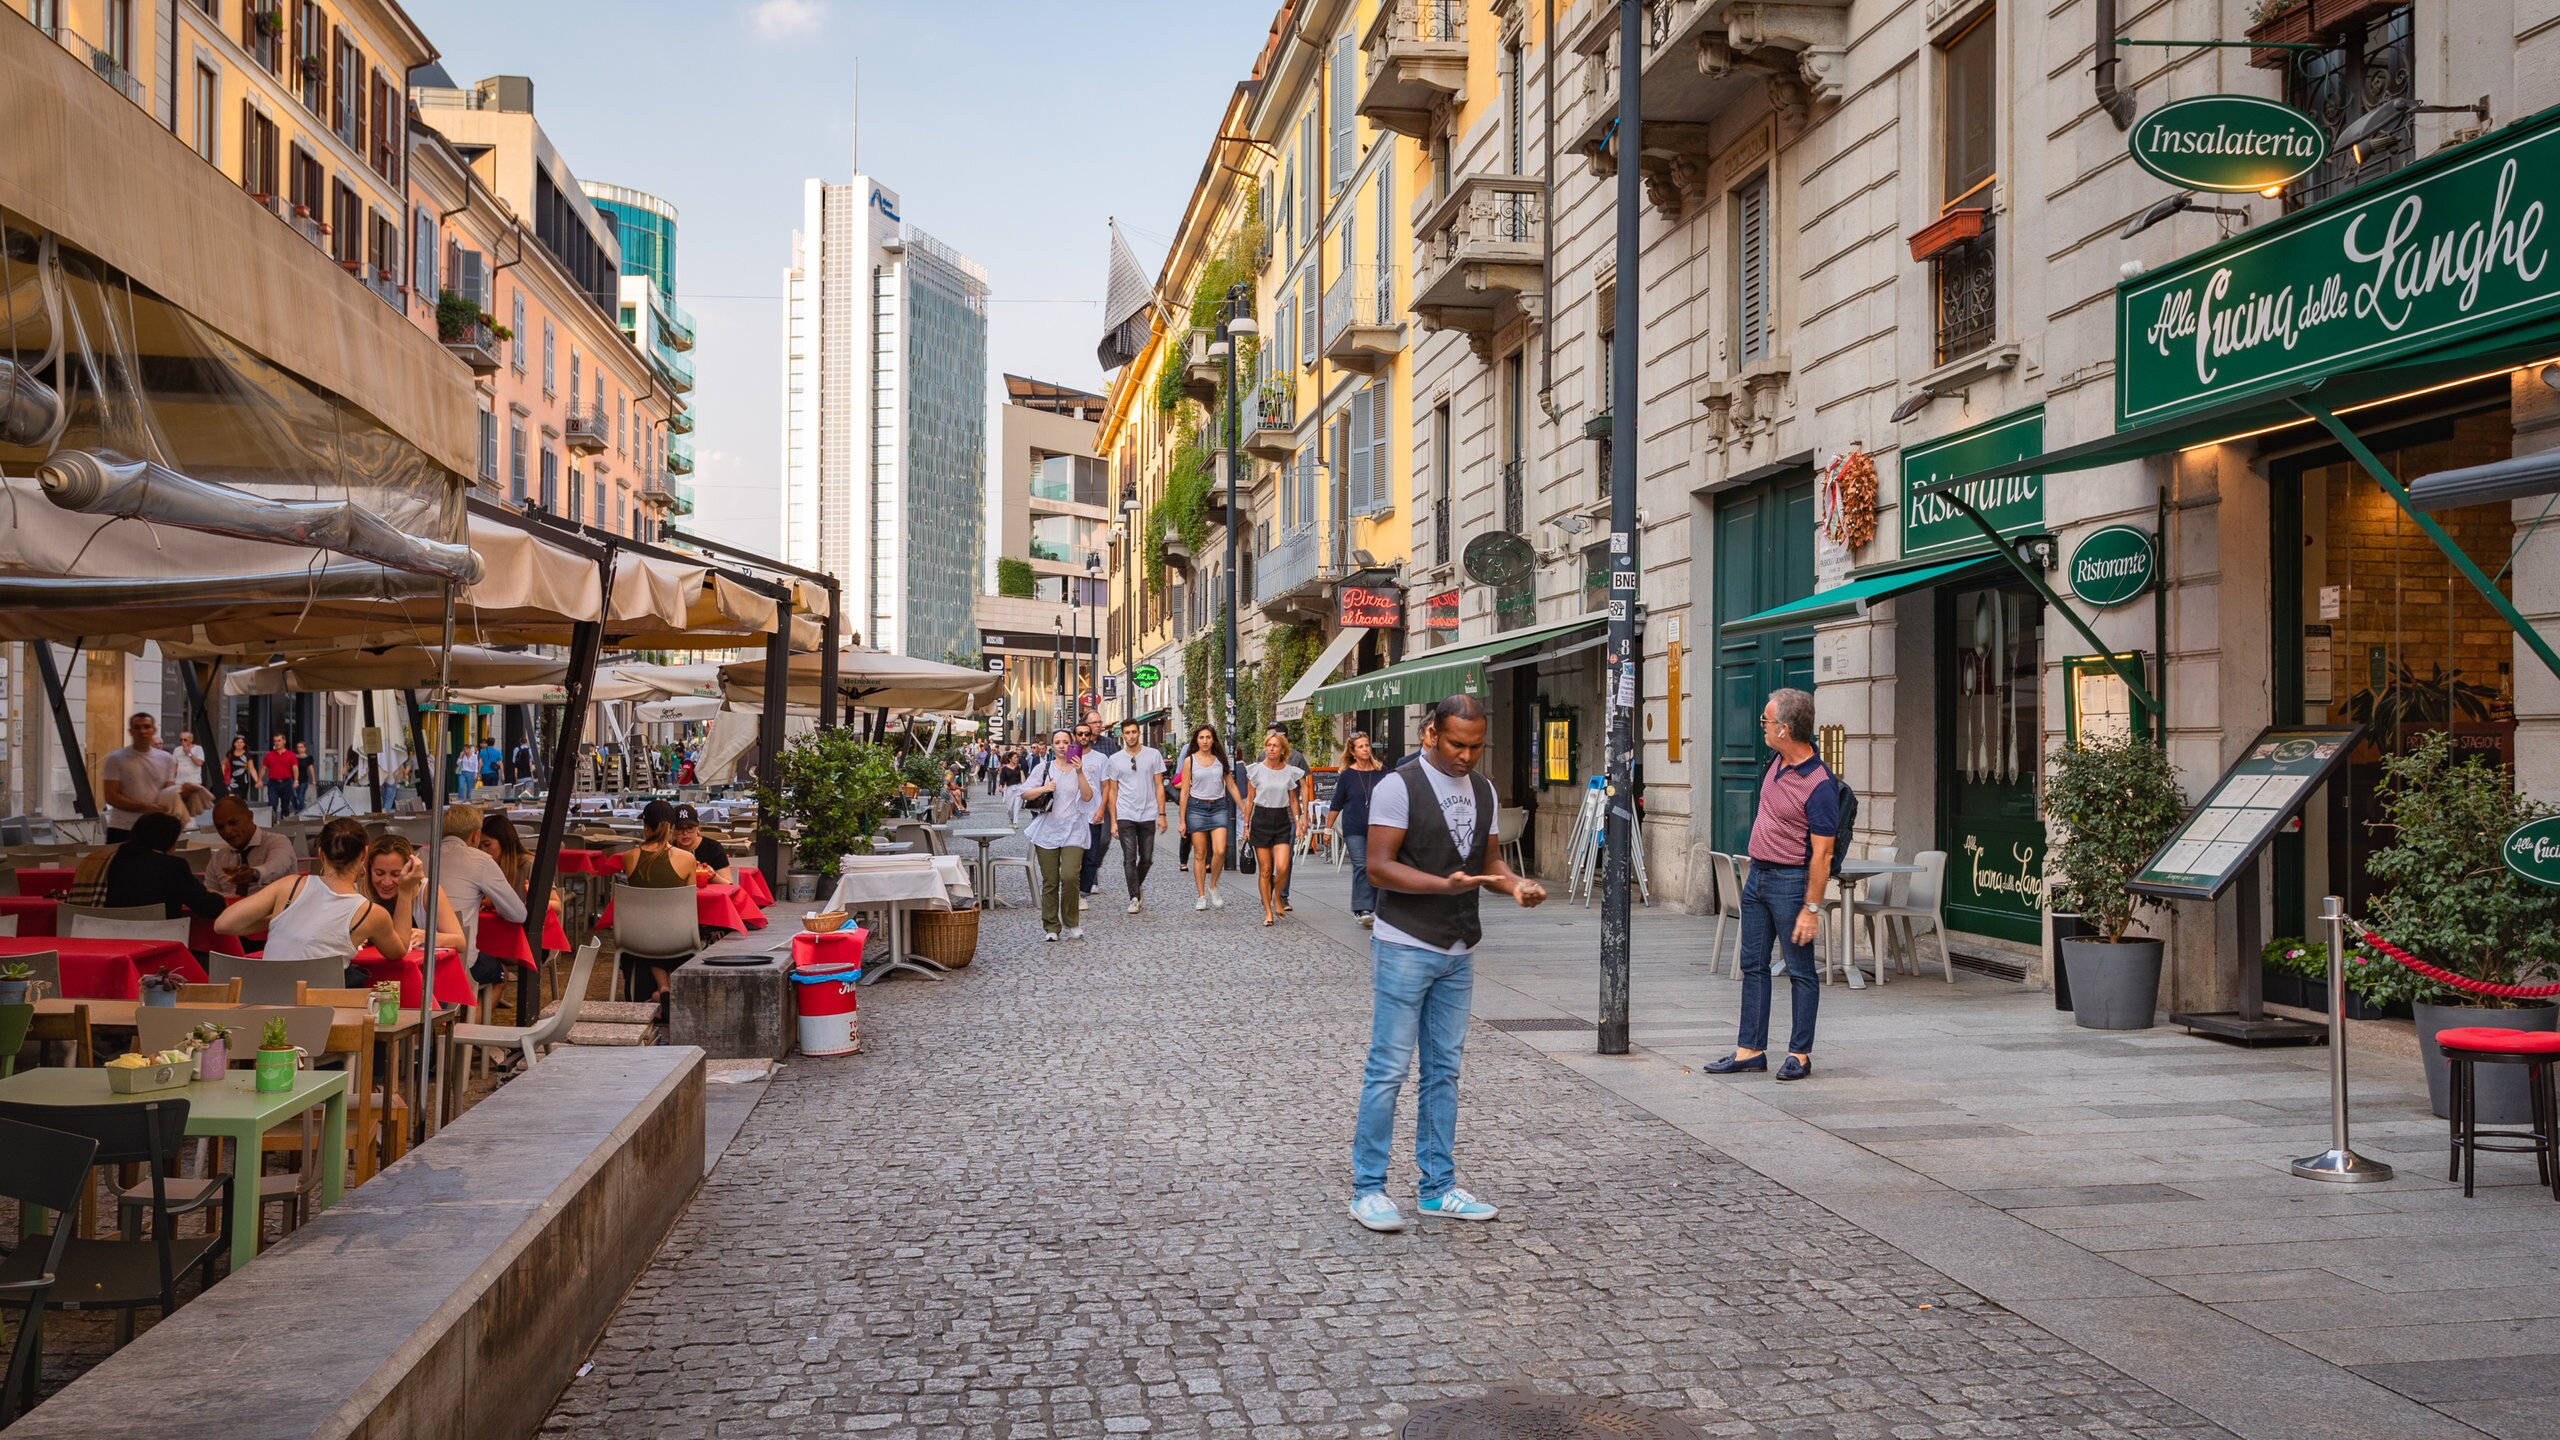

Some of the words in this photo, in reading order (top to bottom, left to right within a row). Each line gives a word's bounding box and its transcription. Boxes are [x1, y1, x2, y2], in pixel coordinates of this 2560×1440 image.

[2148, 124, 2314, 158] Insalateria
[2147, 287, 2196, 357] Alla
[2194, 267, 2299, 385] Cucina
[2298, 274, 2348, 331] delle
[2343, 158, 2549, 332] Langhe
[2076, 551, 2146, 584] Ristorante
[1343, 587, 1397, 609] Pizza
[1341, 610, 1354, 625] al
[1355, 608, 1399, 626] trancio
[421, 678, 459, 687] Heinen
[844, 677, 881, 685] Heineken
[694, 688, 717, 696] Heineke
[2461, 736, 2503, 750] STAGIONE
[1440, 795, 1472, 810] TERDAM
[2511, 836, 2534, 854] Alla
[2534, 836, 2560, 864] Cuci
[2013, 842, 2042, 910] Lang
